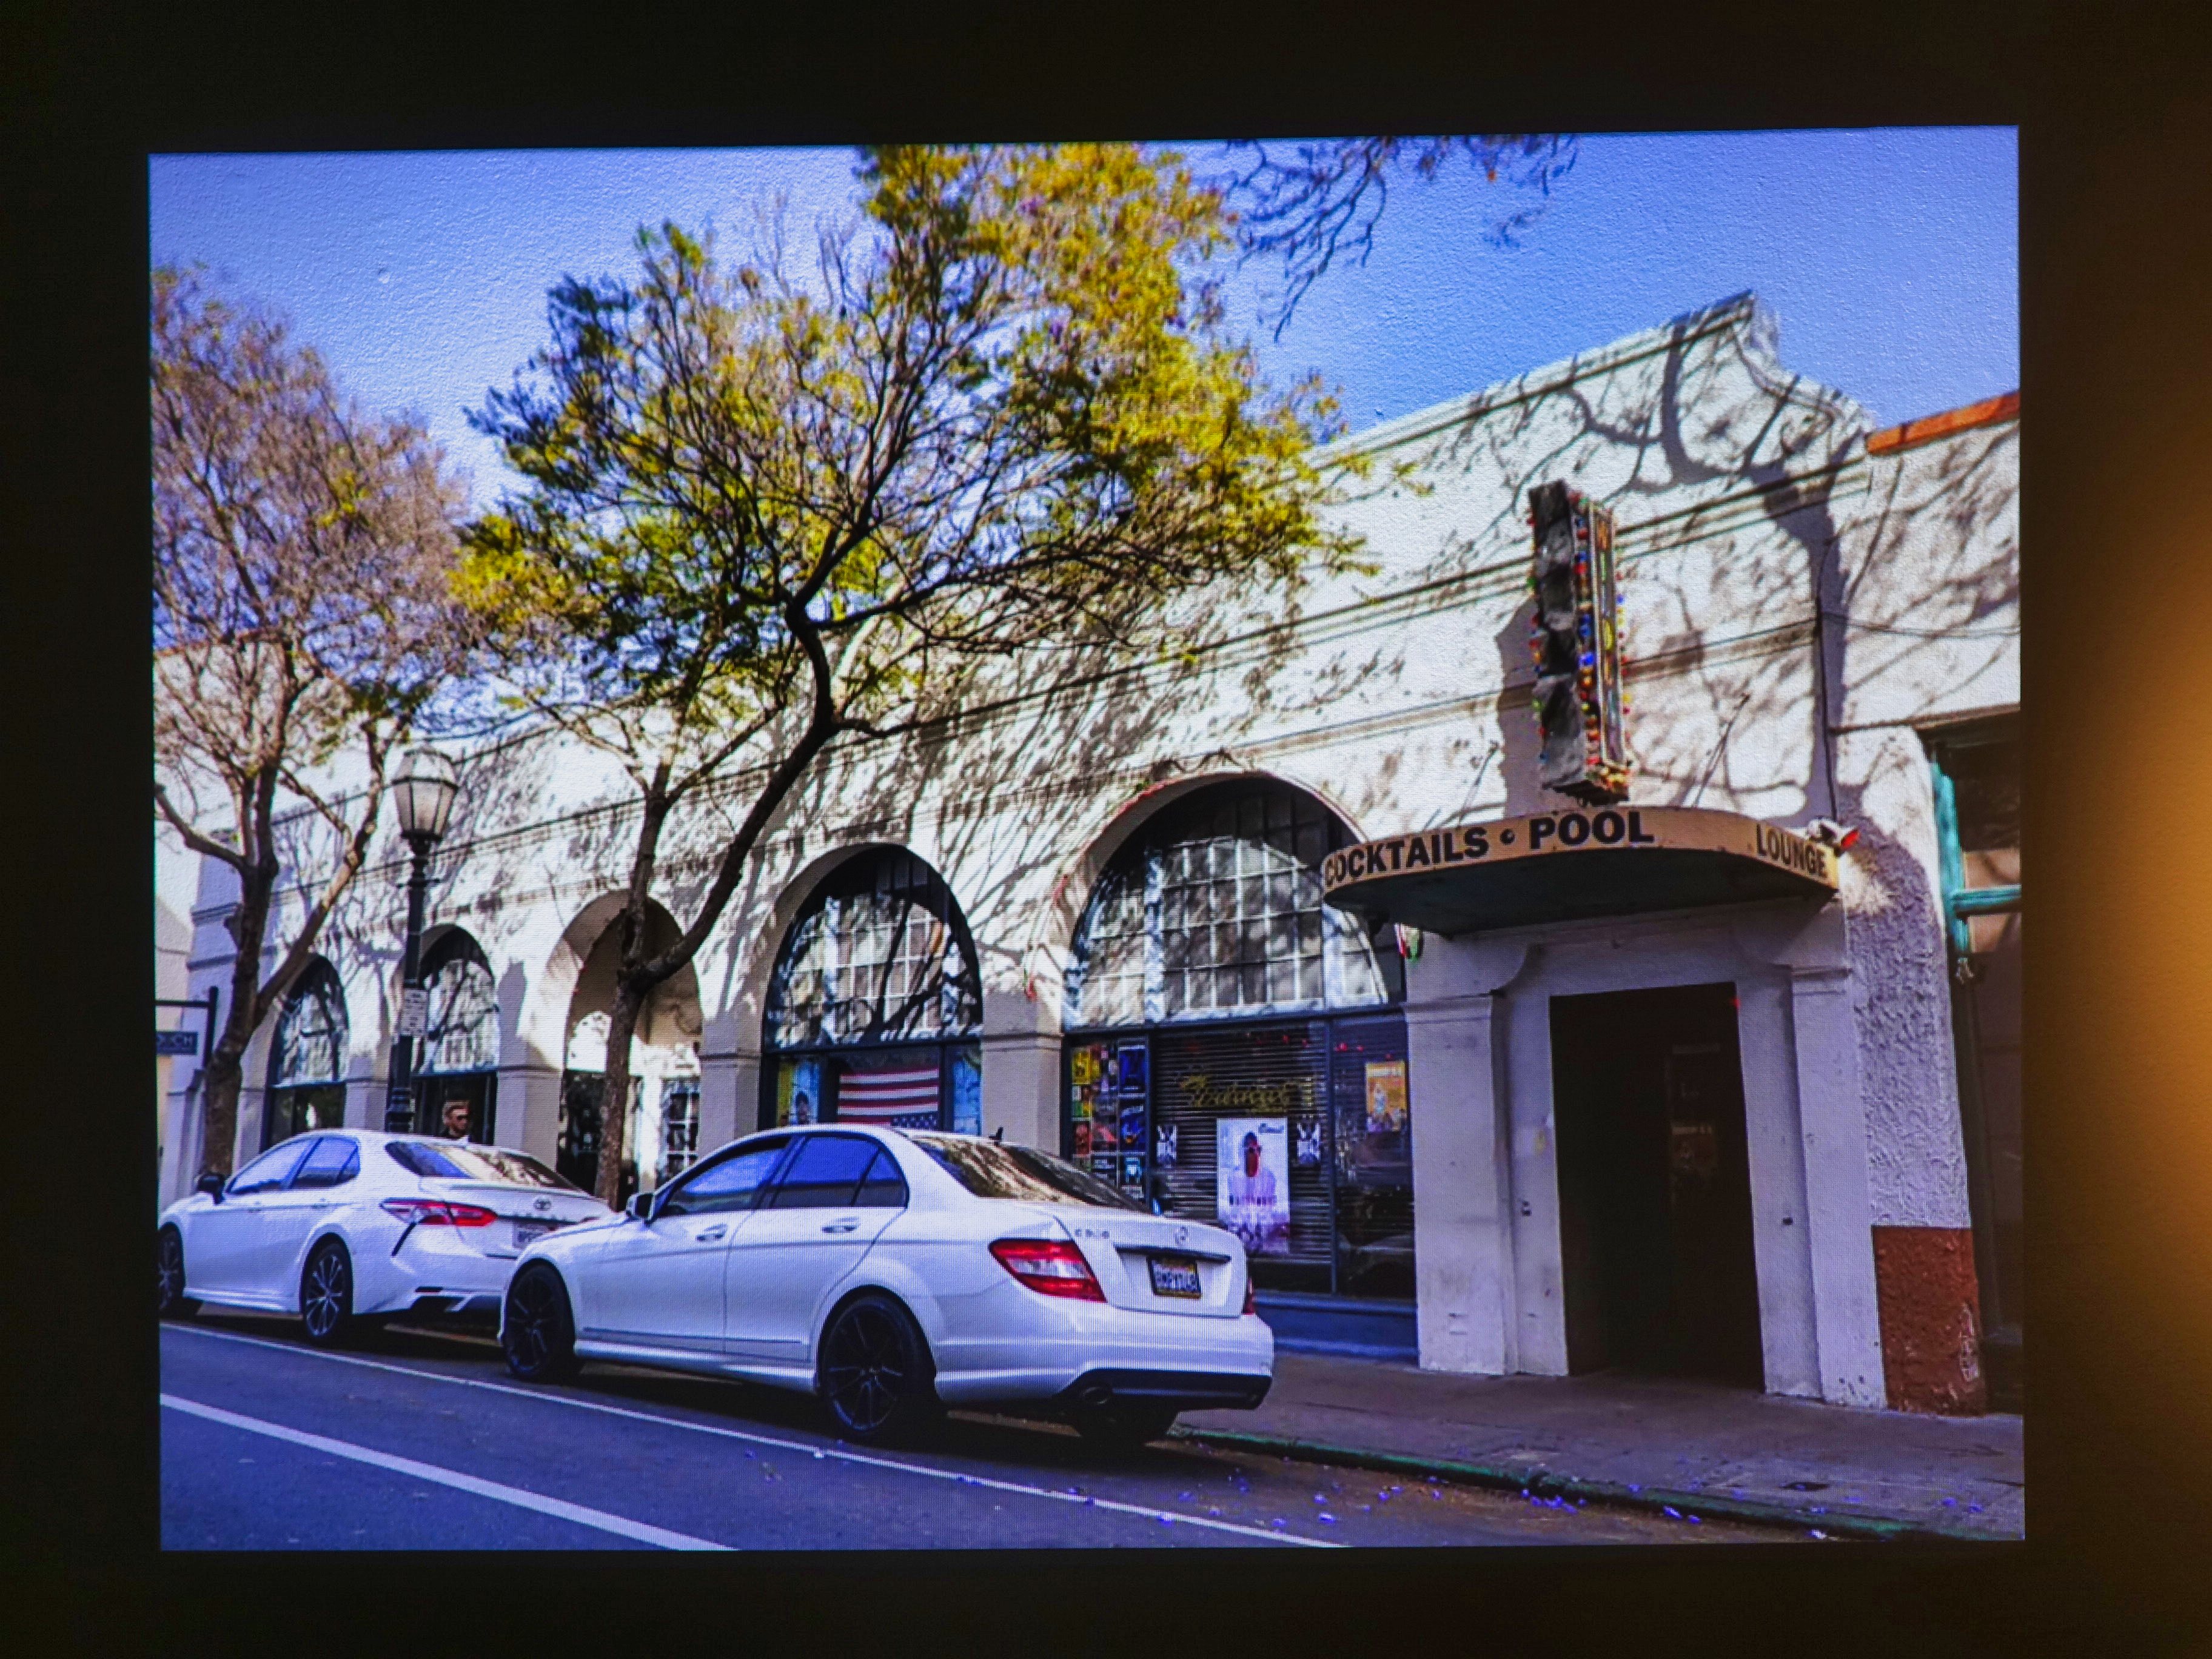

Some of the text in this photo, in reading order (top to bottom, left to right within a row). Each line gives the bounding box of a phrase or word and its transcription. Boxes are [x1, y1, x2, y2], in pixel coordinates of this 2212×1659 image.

[1324, 811, 1828, 887] COCKTAILS POOL LOUNGE
